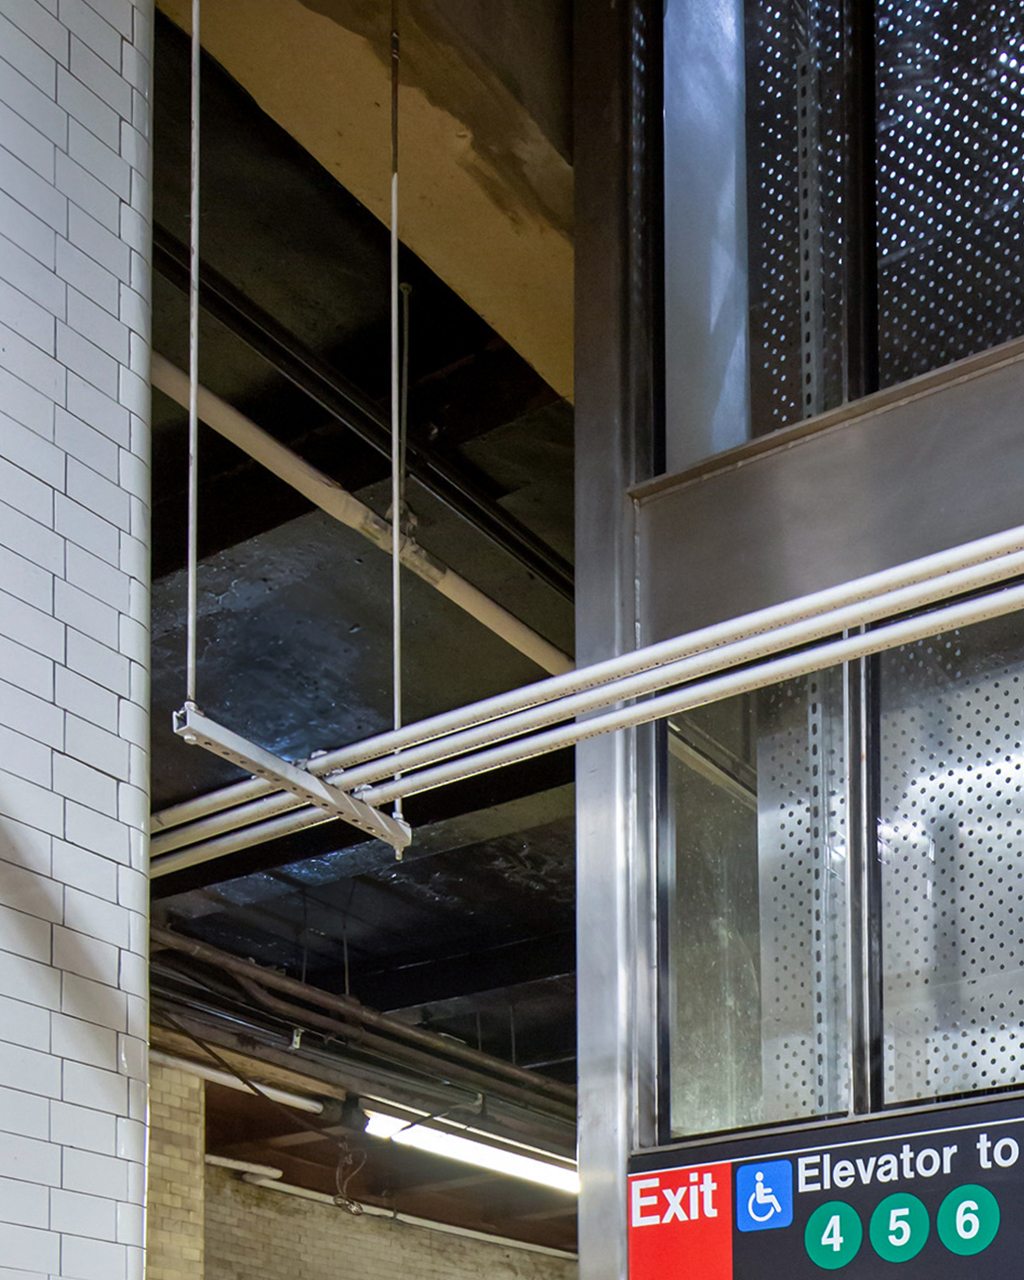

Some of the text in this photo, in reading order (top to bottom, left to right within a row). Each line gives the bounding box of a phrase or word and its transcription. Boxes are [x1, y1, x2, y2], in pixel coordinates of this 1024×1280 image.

[797, 1144, 958, 1193] Elevator
[977, 1133, 1020, 1169] to
[631, 1173, 718, 1227] Exit
[821, 1201, 980, 1252] 4 5 6
